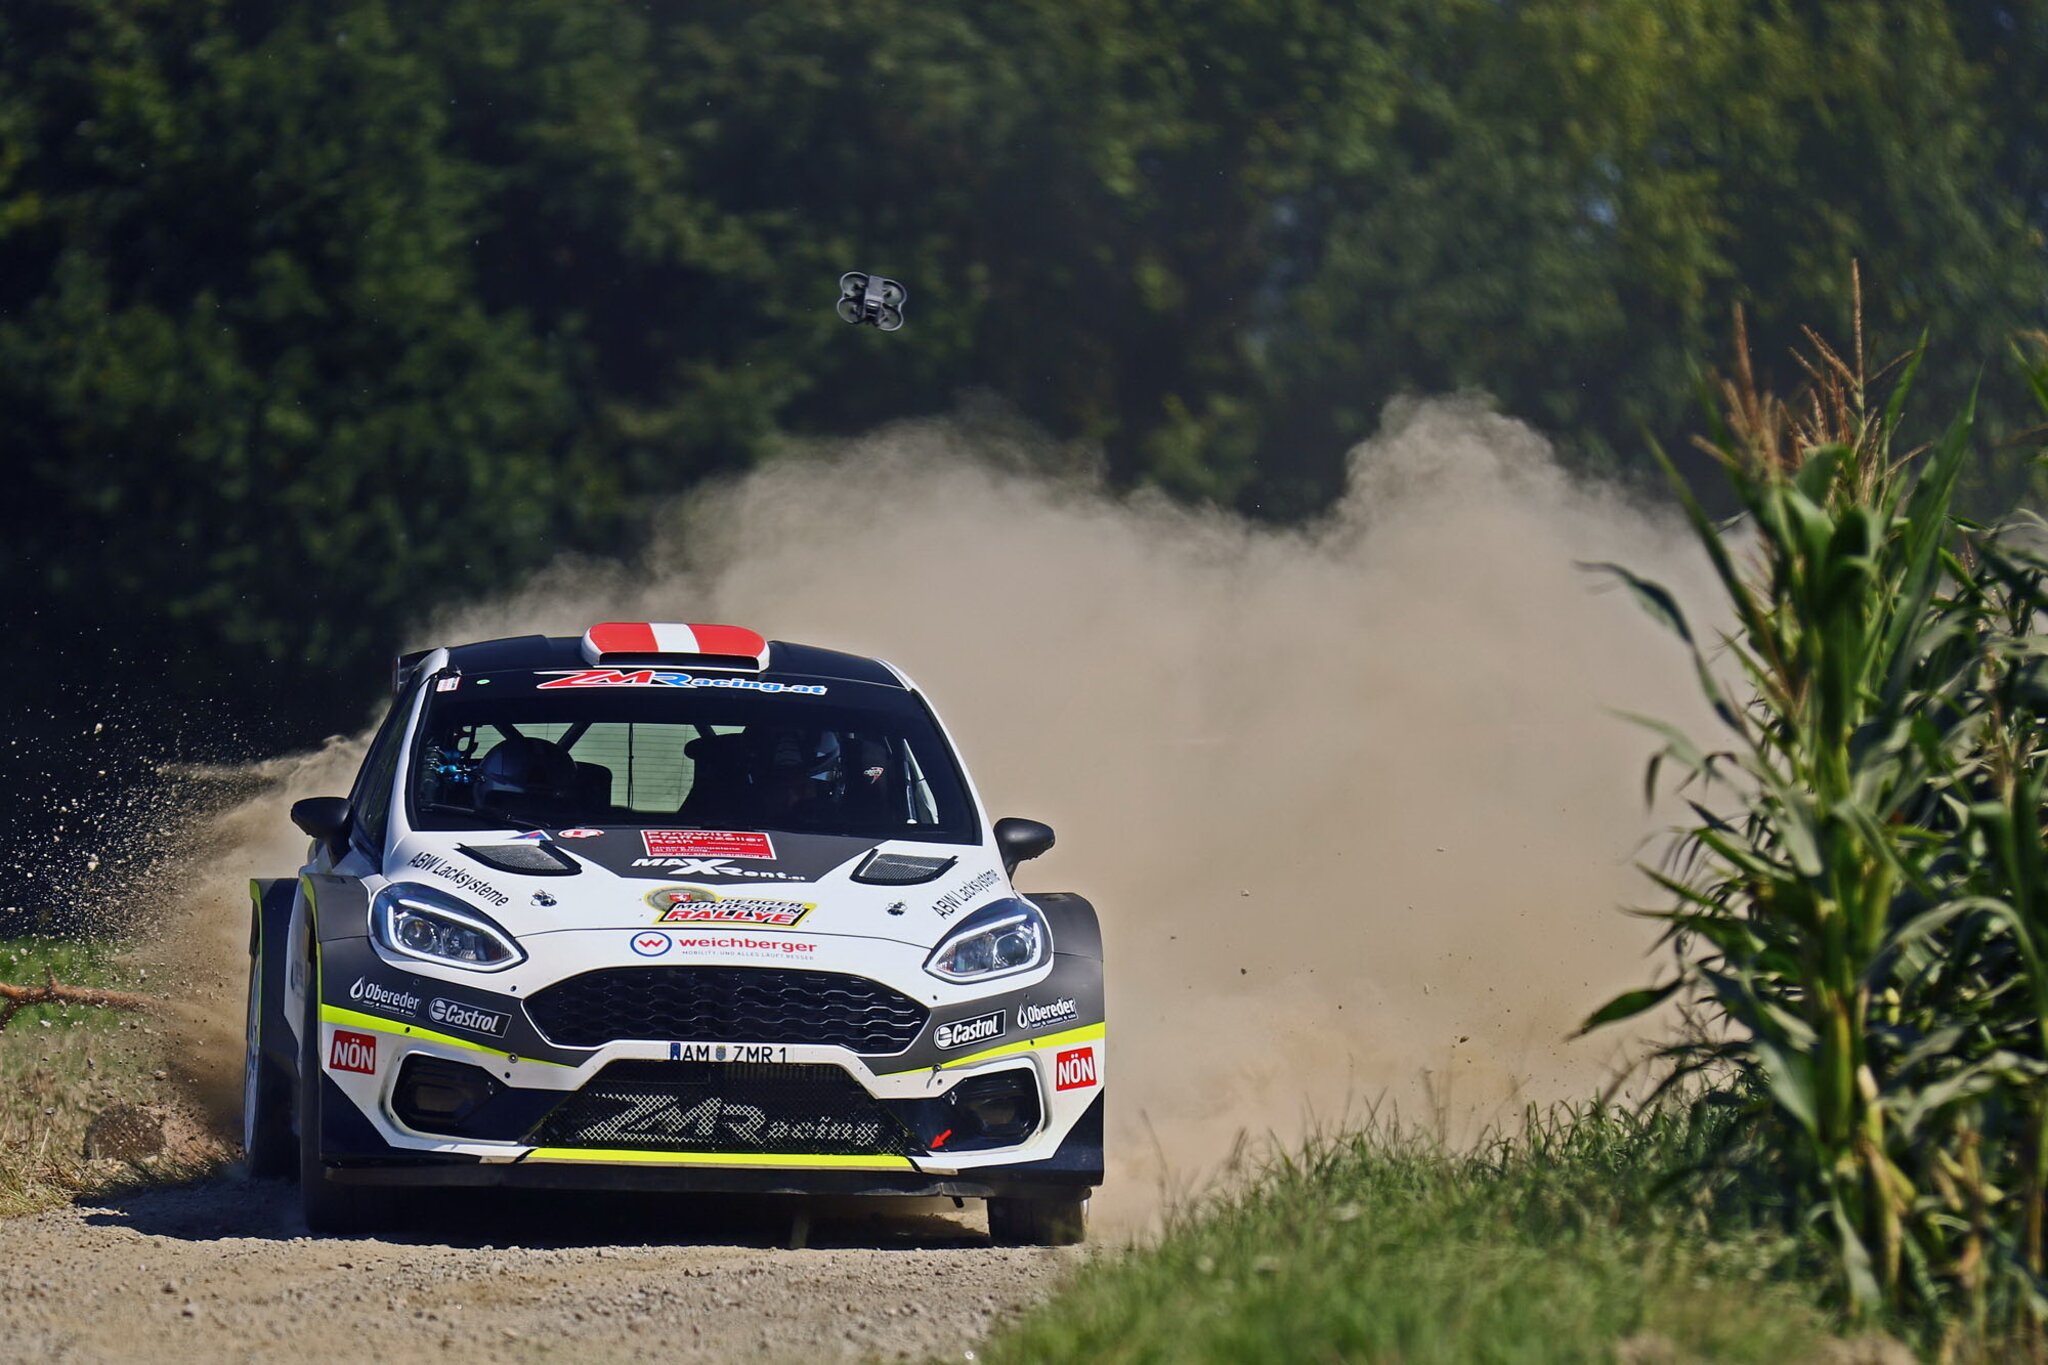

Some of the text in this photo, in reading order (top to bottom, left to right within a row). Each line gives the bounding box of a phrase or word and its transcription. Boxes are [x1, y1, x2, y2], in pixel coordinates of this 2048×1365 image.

[407, 851, 510, 907] ABW Lacksysteme
[666, 910, 797, 924] RALLYE
[932, 893, 962, 920] ABW
[679, 937, 817, 953] weichberger
[364, 982, 420, 1011] Obereder
[1027, 998, 1076, 1022] Obereder
[445, 1004, 500, 1033] Castrol
[952, 1015, 998, 1044] Castrol
[333, 1037, 375, 1071] NÖN
[682, 1044, 710, 1062] AM
[779, 1046, 786, 1064] 1
[1058, 1052, 1095, 1086] NÖN
